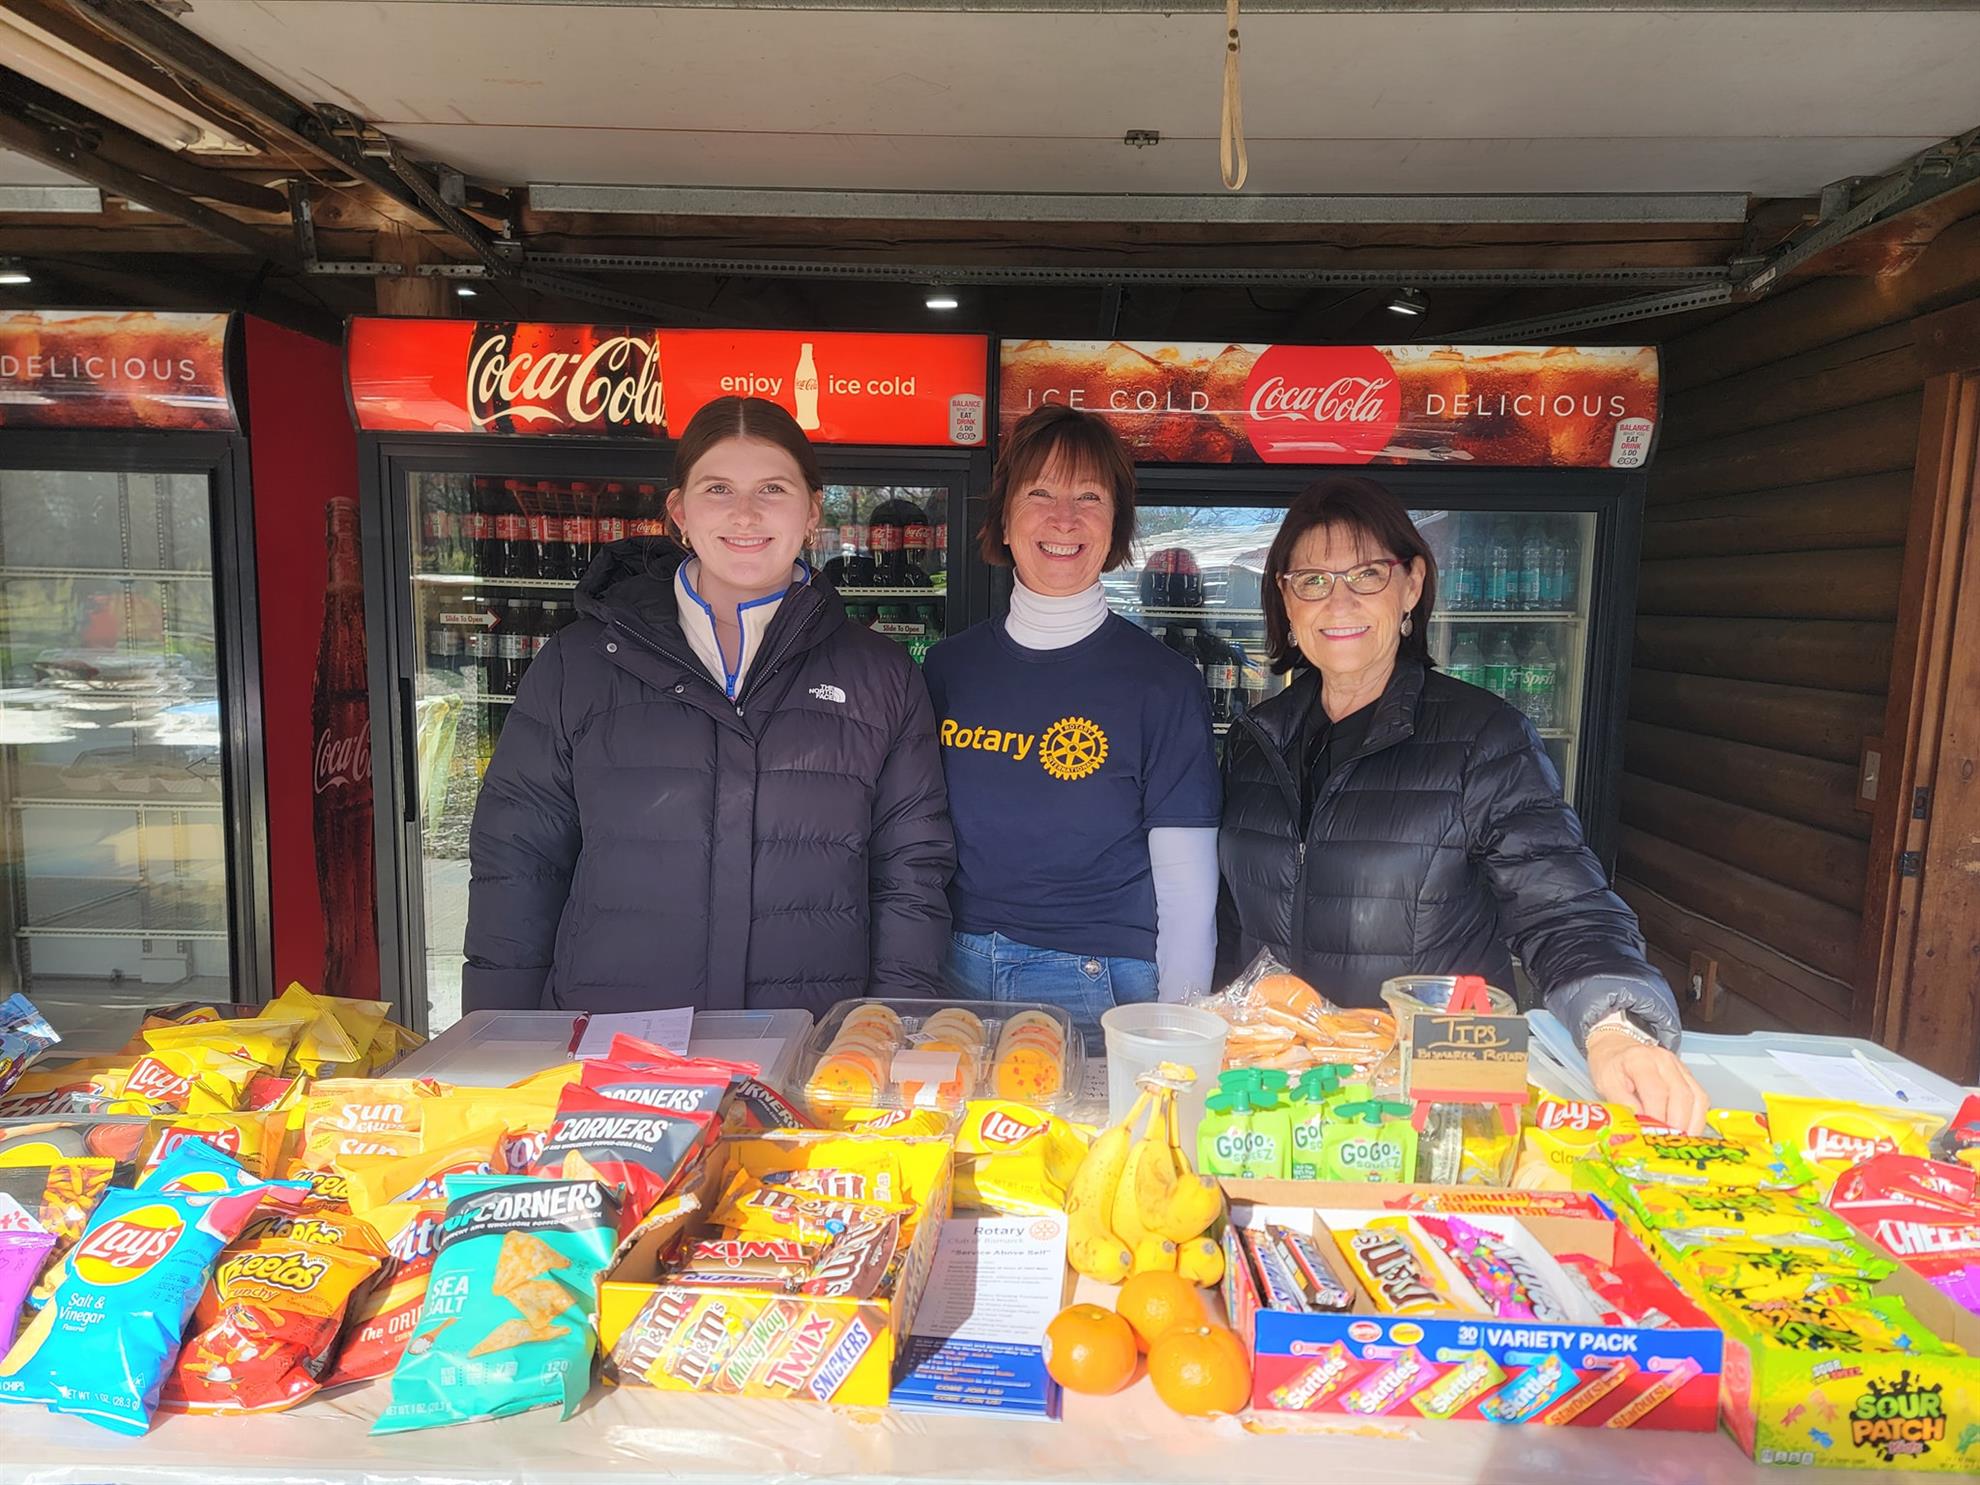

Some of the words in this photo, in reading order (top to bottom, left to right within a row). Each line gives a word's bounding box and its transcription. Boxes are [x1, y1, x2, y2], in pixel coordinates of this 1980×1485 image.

[2, 355, 197, 381] DELICIOUS
[467, 334, 666, 426] Coca-Cola
[720, 373, 783, 396] enjoy
[829, 375, 861, 394] ice
[866, 377, 916, 396] cold
[1028, 389, 1085, 409] ICE
[1110, 390, 1210, 413] COLD
[1251, 377, 1392, 422] Coca-Cola
[1426, 394, 1625, 417] DELICIOUS
[882, 624, 896, 633] Slide
[897, 625, 904, 633] To
[905, 624, 920, 635] Open
[941, 719, 1035, 760] Rotary
[337, 1103, 404, 1131] Sun
[79, 1222, 178, 1267] Lay's
[974, 1226, 1025, 1237] Rotary
[68, 1292, 93, 1307] Salt
[93, 1296, 106, 1310] &
[432, 1275, 469, 1299] SEA
[59, 1305, 105, 1326] Vinegar
[1458, 1326, 1478, 1341] 30
[1487, 1328, 1576, 1350] VARIETY
[1579, 1333, 1638, 1352] PACK
[811, 1322, 869, 1401] SNICKERS
[2, 1381, 25, 1392] CHIPS
[1287, 1356, 1347, 1410] Skittles
[1359, 1358, 1420, 1414] Skittles
[1432, 1362, 1489, 1413] Skittles
[1500, 1365, 1562, 1419] Skittles
[1855, 1392, 1942, 1420] SOUR
[1851, 1417, 1945, 1446] PATCH
